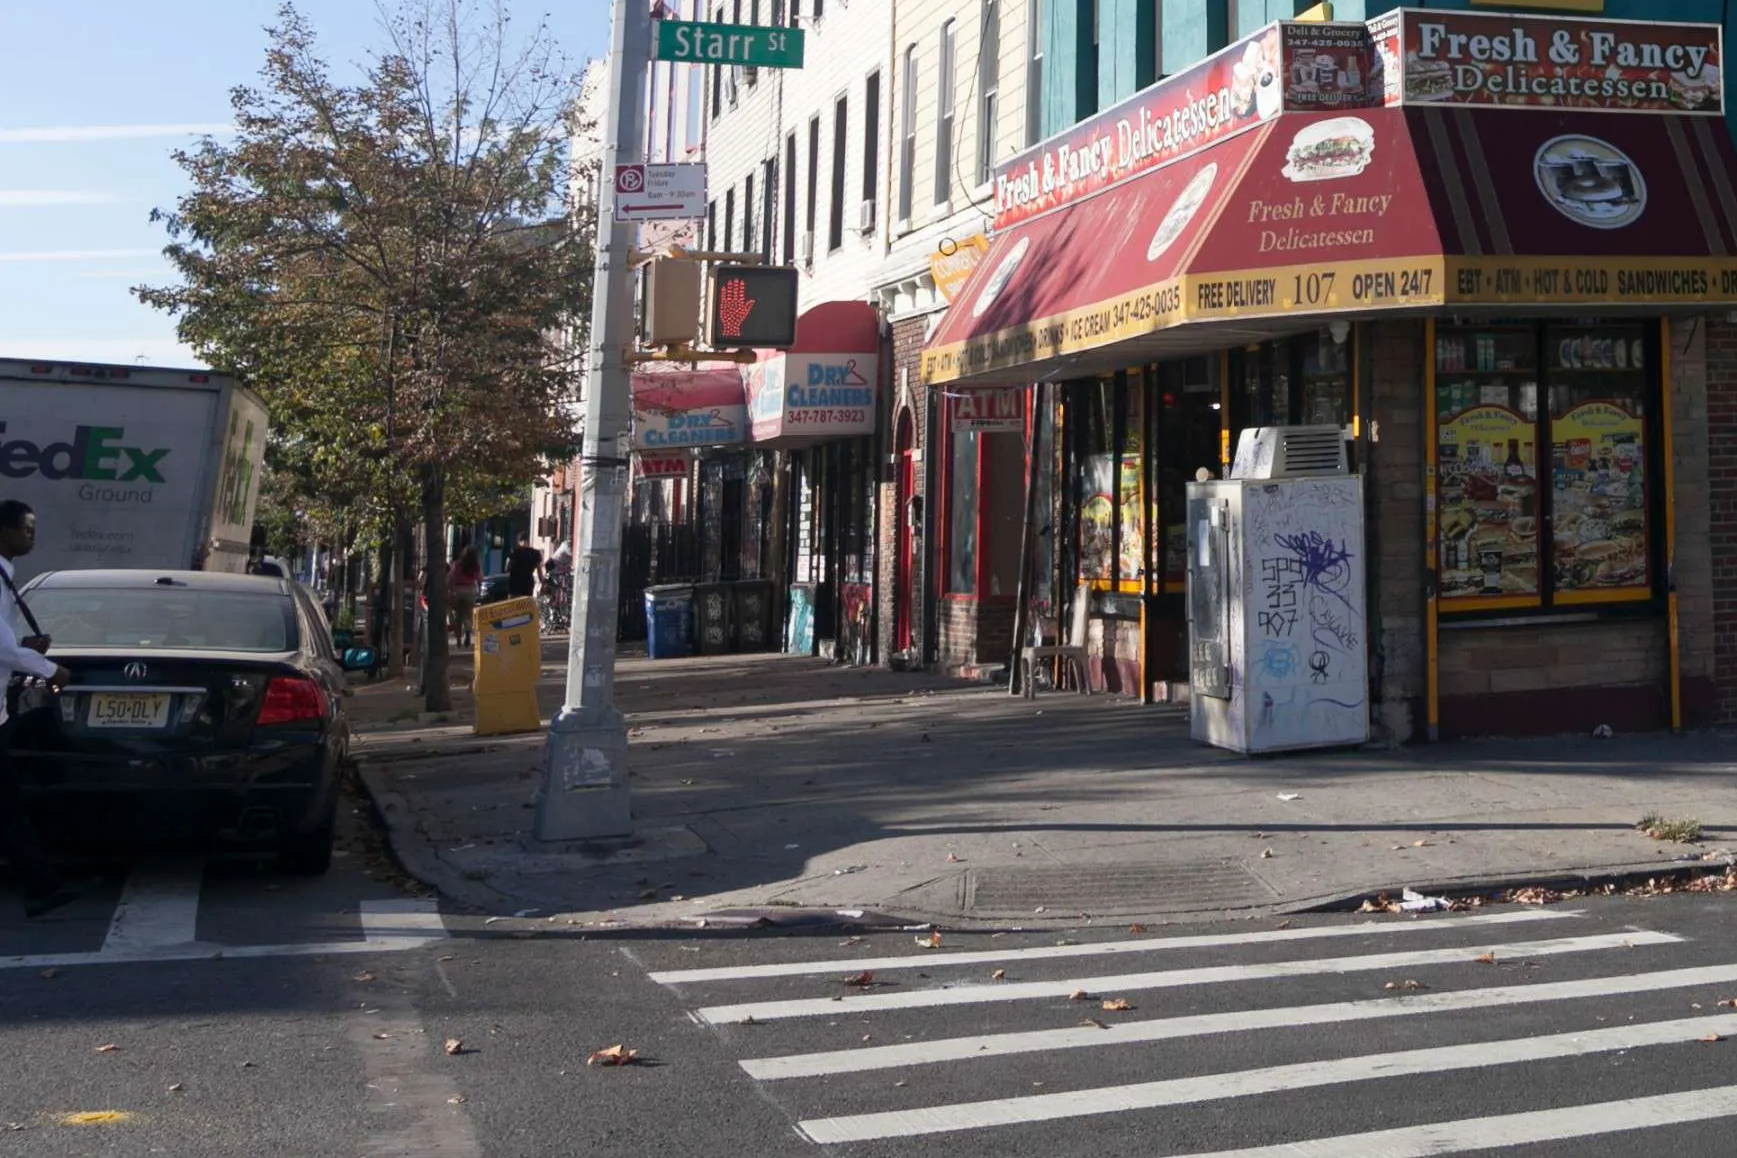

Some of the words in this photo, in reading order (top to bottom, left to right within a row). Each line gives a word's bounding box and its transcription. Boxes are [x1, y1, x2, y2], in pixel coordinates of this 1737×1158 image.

[674, 26, 755, 60] Starr
[768, 32, 786, 51] St
[1418, 22, 1538, 62] Fresh
[1549, 29, 1580, 64] &
[1588, 31, 1709, 79] Fancy
[1454, 64, 1670, 99] Delicatessen
[997, 161, 1039, 212] Fresh
[1043, 152, 1056, 193] &
[1058, 134, 1110, 188] Fancy
[1116, 87, 1232, 169] Delicatessen
[1248, 200, 1304, 223] Fresh
[1309, 195, 1325, 216] &
[1329, 193, 1392, 218] Fancy
[1258, 227, 1374, 252] Delicatessen
[1198, 281, 1224, 309] FREE
[1226, 278, 1277, 308] DELIVERY
[1293, 272, 1337, 305] 107
[1352, 271, 1396, 299] OPEN
[1401, 268, 1433, 297] 24/7
[1458, 269, 1481, 293] EBT
[1495, 269, 1521, 293] ATM
[1534, 269, 1559, 293] HOT
[1563, 269, 1572, 293] &
[1575, 269, 1609, 294] COLD
[1617, 269, 1709, 295] SANDWICHES
[1070, 319, 1083, 342] ICE
[1085, 311, 1111, 336] CREAM
[1112, 286, 1181, 329] 347-425-0035
[807, 363, 850, 387] DRY
[788, 385, 872, 407] CLEANERS
[957, 388, 1019, 417] ATM
[788, 409, 865, 424] 347-787-3923
[78, 484, 152, 503] Ground
